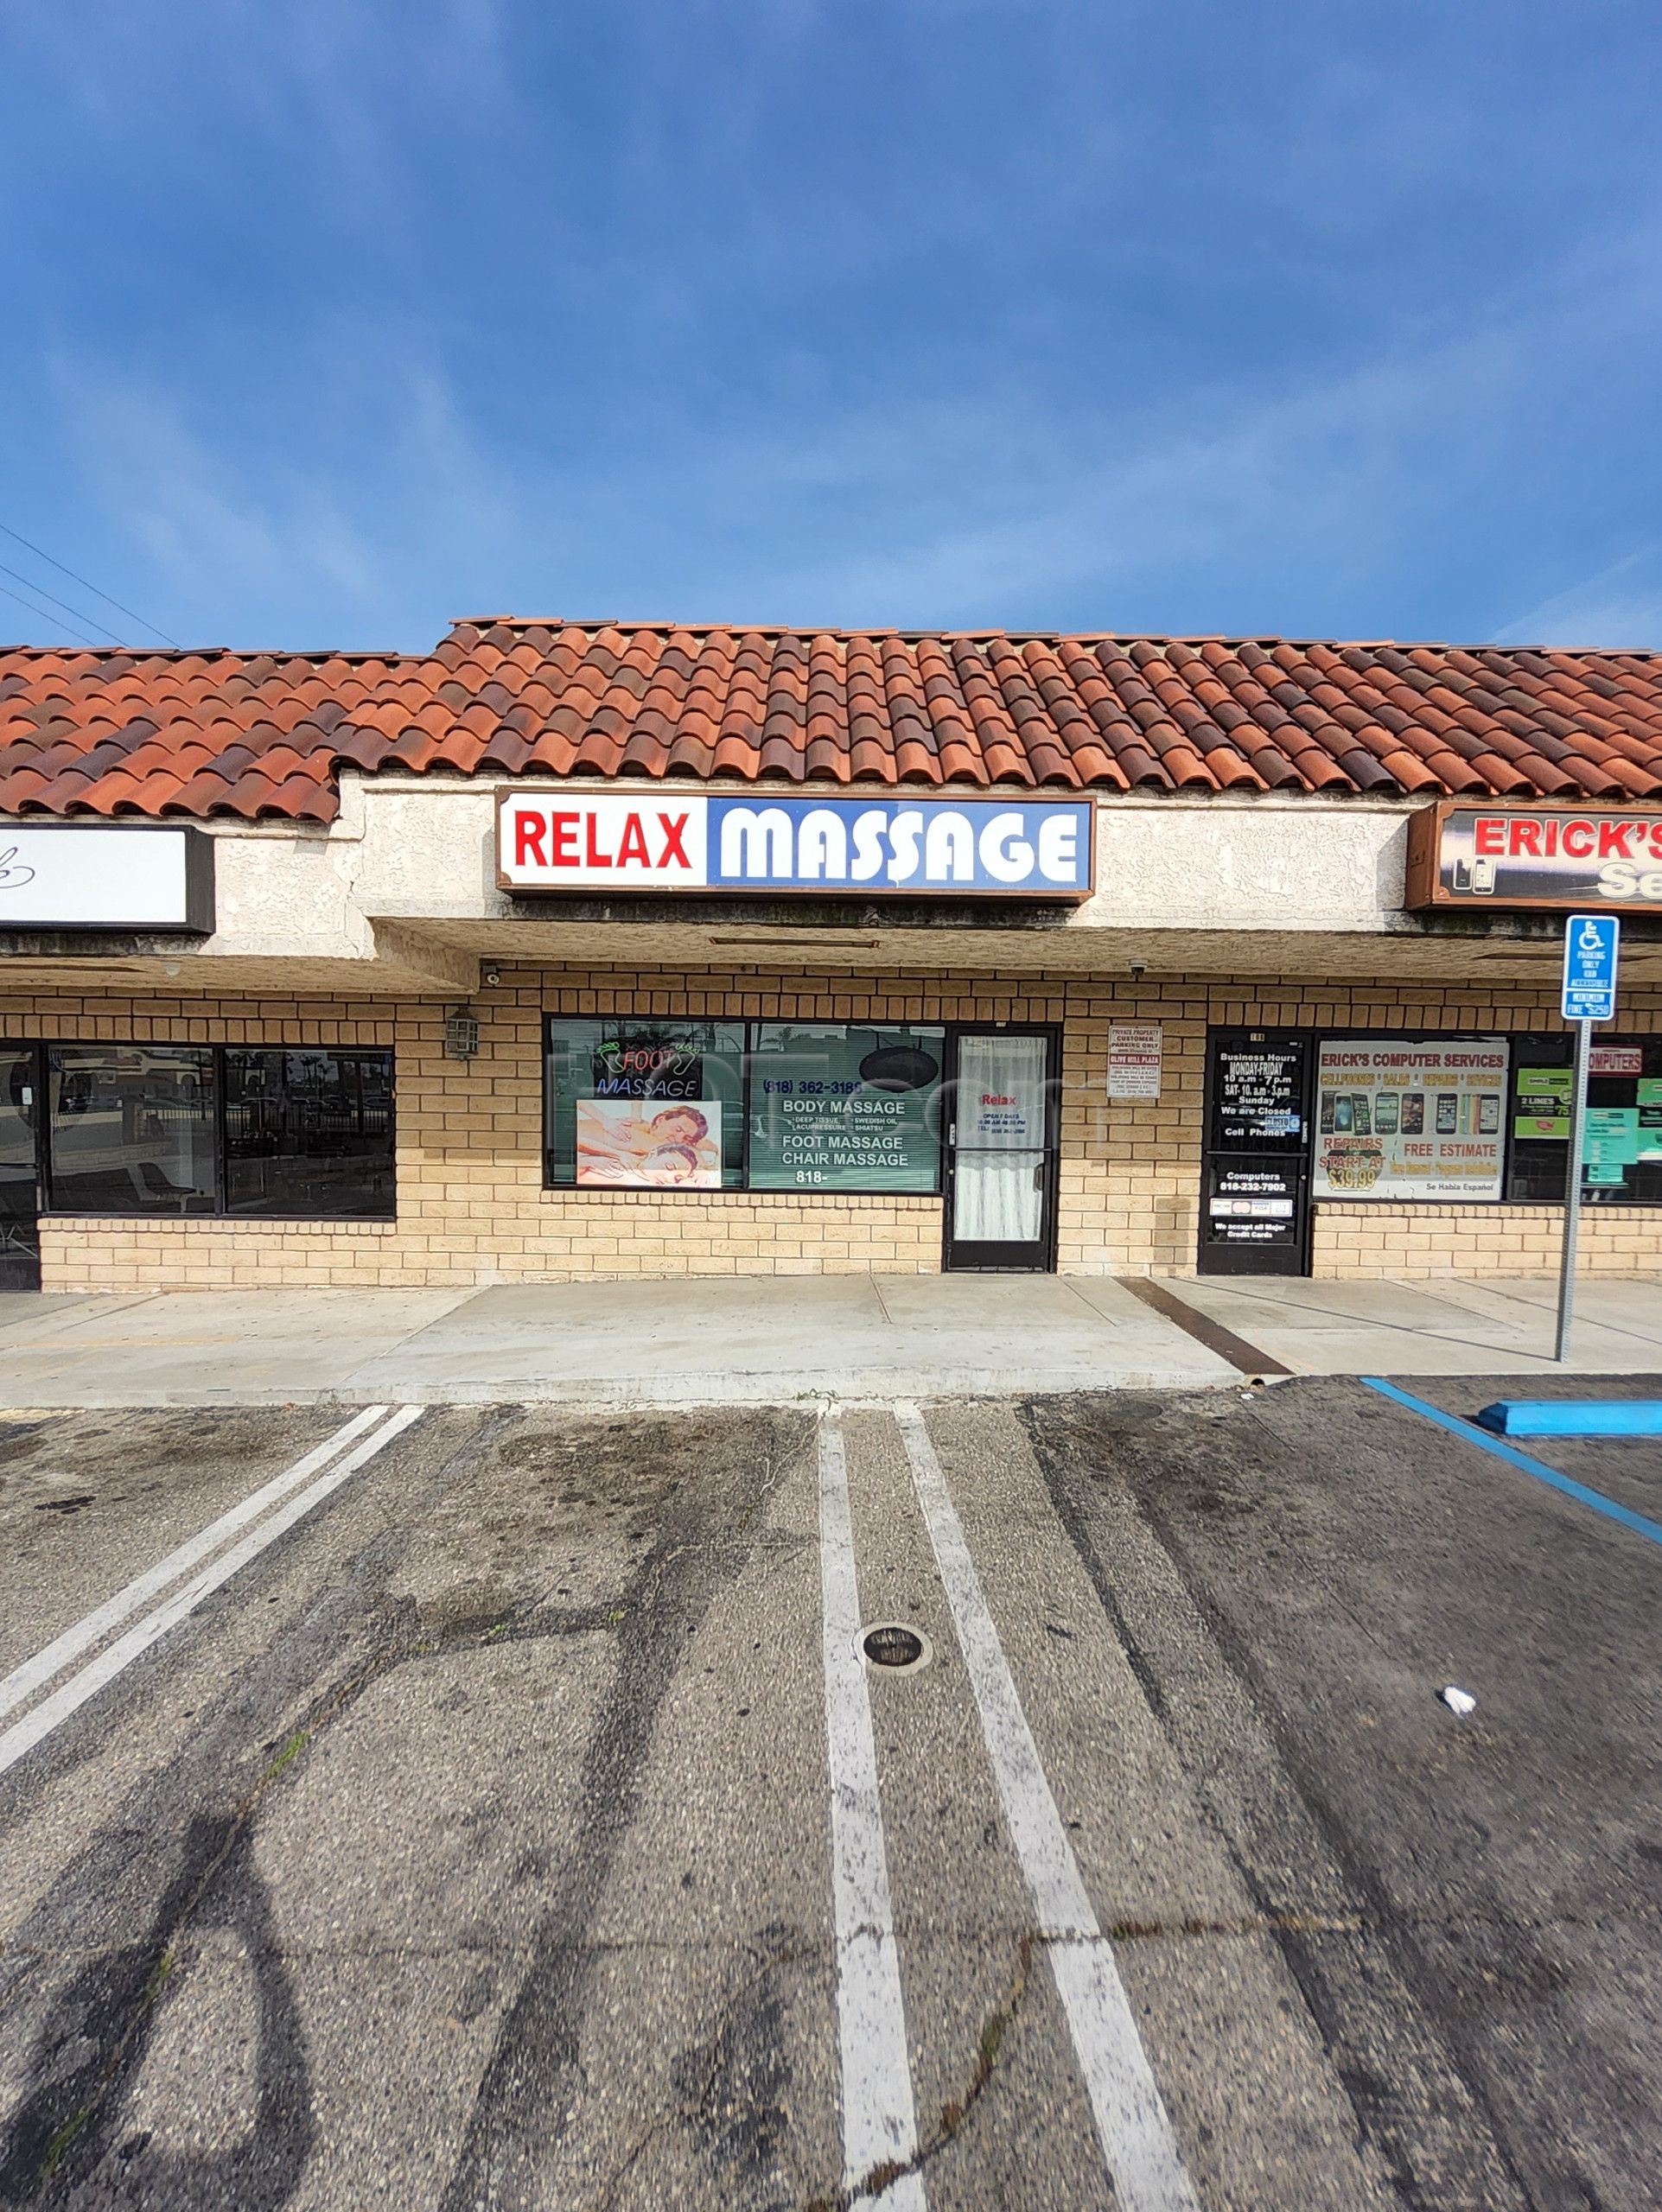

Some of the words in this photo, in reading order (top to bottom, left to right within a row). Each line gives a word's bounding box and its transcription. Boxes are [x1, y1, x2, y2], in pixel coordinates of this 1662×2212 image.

[514, 810, 693, 868] RELAX
[720, 807, 1079, 882] MASSAGE
[624, 1051, 675, 1071] FOOT
[1321, 1053, 1369, 1067] ERICK'S
[1372, 1053, 1441, 1067] COMPUTER
[1444, 1054, 1504, 1068] SERVICES
[1589, 1052, 1641, 1070] OMPUTERS
[1229, 1062, 1283, 1076] MONDAY-FRIDAY
[596, 1077, 697, 1096] MASSAGE
[762, 1079, 793, 1094] (818)
[1264, 1076, 1272, 1085] 7
[982, 1094, 1016, 1105] Relax
[1239, 1096, 1275, 1106] Sunday
[783, 1100, 826, 1113] BODY
[830, 1101, 906, 1115] MASSAGE
[782, 1135, 824, 1147] FOOT
[828, 1136, 903, 1149] MASSAGE
[1323, 1138, 1383, 1149] REPAIRS
[1404, 1143, 1433, 1157] FREE
[1440, 1143, 1497, 1157] ESTIMATE
[782, 1152, 830, 1165] CHAIR
[833, 1154, 908, 1166] MASSAGE
[1319, 1156, 1363, 1168] START
[1369, 1156, 1385, 1168] AT
[796, 1171, 828, 1183] 818-
[1226, 1172, 1280, 1181] Computers
[1328, 1168, 1376, 1189] $39.99
